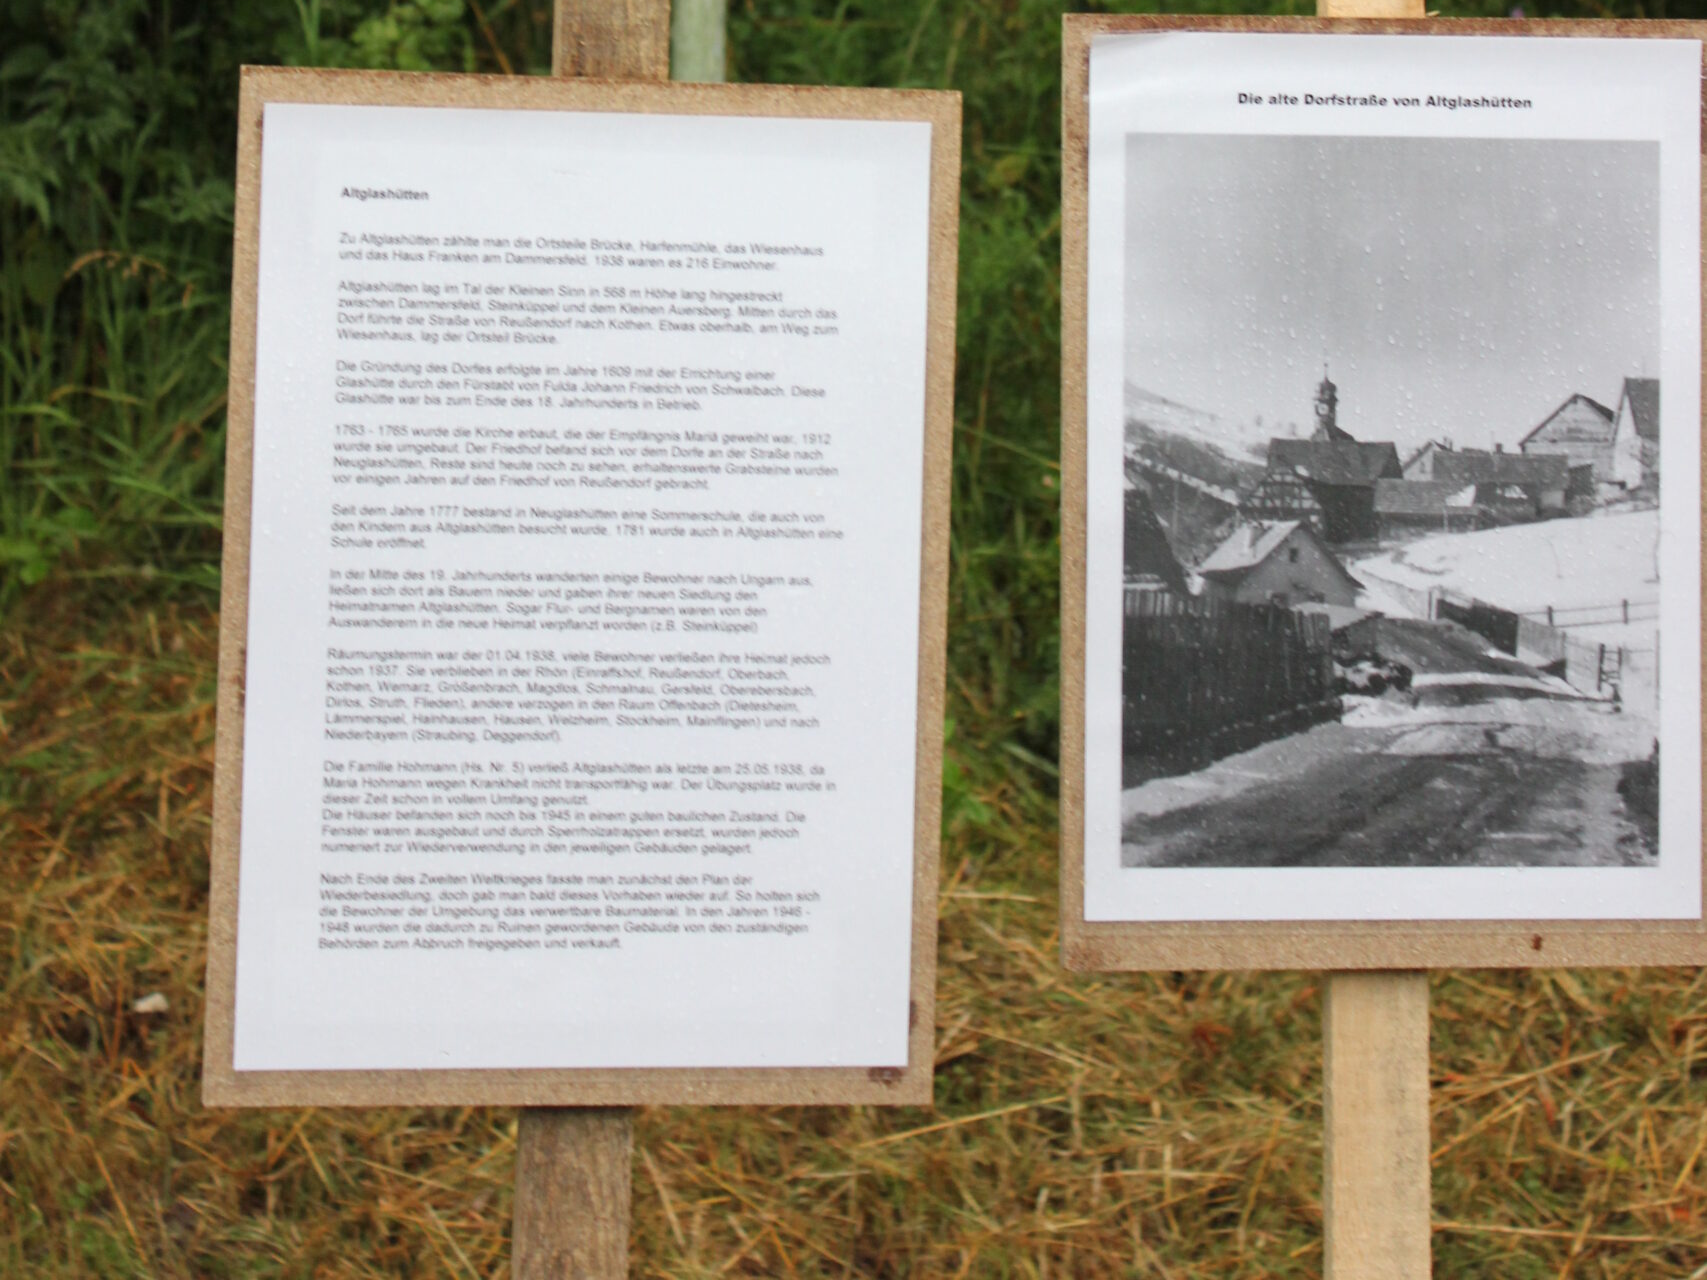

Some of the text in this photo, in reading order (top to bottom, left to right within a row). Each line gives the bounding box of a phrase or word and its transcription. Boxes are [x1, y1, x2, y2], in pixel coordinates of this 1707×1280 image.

[1238, 93, 1532, 110] Die alte Dorfstraße von Altglashütten
[340, 187, 429, 203] Altglashütten
[358, 233, 824, 256] Altglashütten zählte die Ortsteile das Wiesenhaus
[338, 248, 665, 267] und das waren
[337, 280, 783, 304] Altglashütten Höhe hingestreckt
[737, 305, 838, 319] Mitten durch das
[658, 320, 838, 336] Etwas Weg zum
[419, 330, 510, 344] lag der Ortsteil
[335, 360, 776, 380] Die erfolgte Jahre der einer
[335, 376, 826, 397] Glashütte von Diese
[334, 392, 639, 409] Glashütte des Jahrhunderts
[411, 426, 769, 446] wurde Mariä geweiht
[332, 440, 823, 460] wurde Straße nach
[631, 461, 839, 476] erhaltenswerte Grabsteine wurden
[331, 473, 470, 487] vor einigen auf
[331, 504, 825, 523] Seit Neuglashütten eine die auch von
[434, 522, 844, 541] Altglashütten besucht wurde auch Altglashütten eine
[329, 536, 373, 547] Schule
[368, 569, 785, 587] Mitte wanderten einige Bewohner Ungarn
[328, 584, 732, 603] ließen gaben Siedlung
[327, 600, 768, 618] Heimatnamen Bergnamen den
[327, 616, 600, 632] Auswanderern die neue Heimat verpflanzt
[326, 648, 831, 667] Räumungstermin viele Bewohner jedoch
[326, 664, 494, 676] schon Sie verblieben
[516, 699, 721, 712] verzogen Raum Offenbach
[763, 716, 787, 727] und
[789, 717, 820, 727] nach
[323, 729, 408, 743] Niederbayern
[323, 761, 709, 776] Die Altglashütten als letzte
[322, 777, 822, 793] Maria wegen Übungsplatz wurde
[321, 793, 487, 804] dieser Zeit vollem
[321, 809, 807, 822] Die baulichen Die
[413, 825, 800, 840] ausgebaut wurden jedoch
[320, 841, 631, 855] numeriert Wiederverwendung jeweiligen
[418, 873, 673, 887] Zweiten Weltkrieges fasste zunächst
[664, 890, 821, 901] wieder holten sich
[318, 905, 769, 917] die verwertbare Jahren
[623, 922, 809, 935] Gebäude von zuständigen
[317, 938, 541, 951] Behörden Abbruch freigegeben
